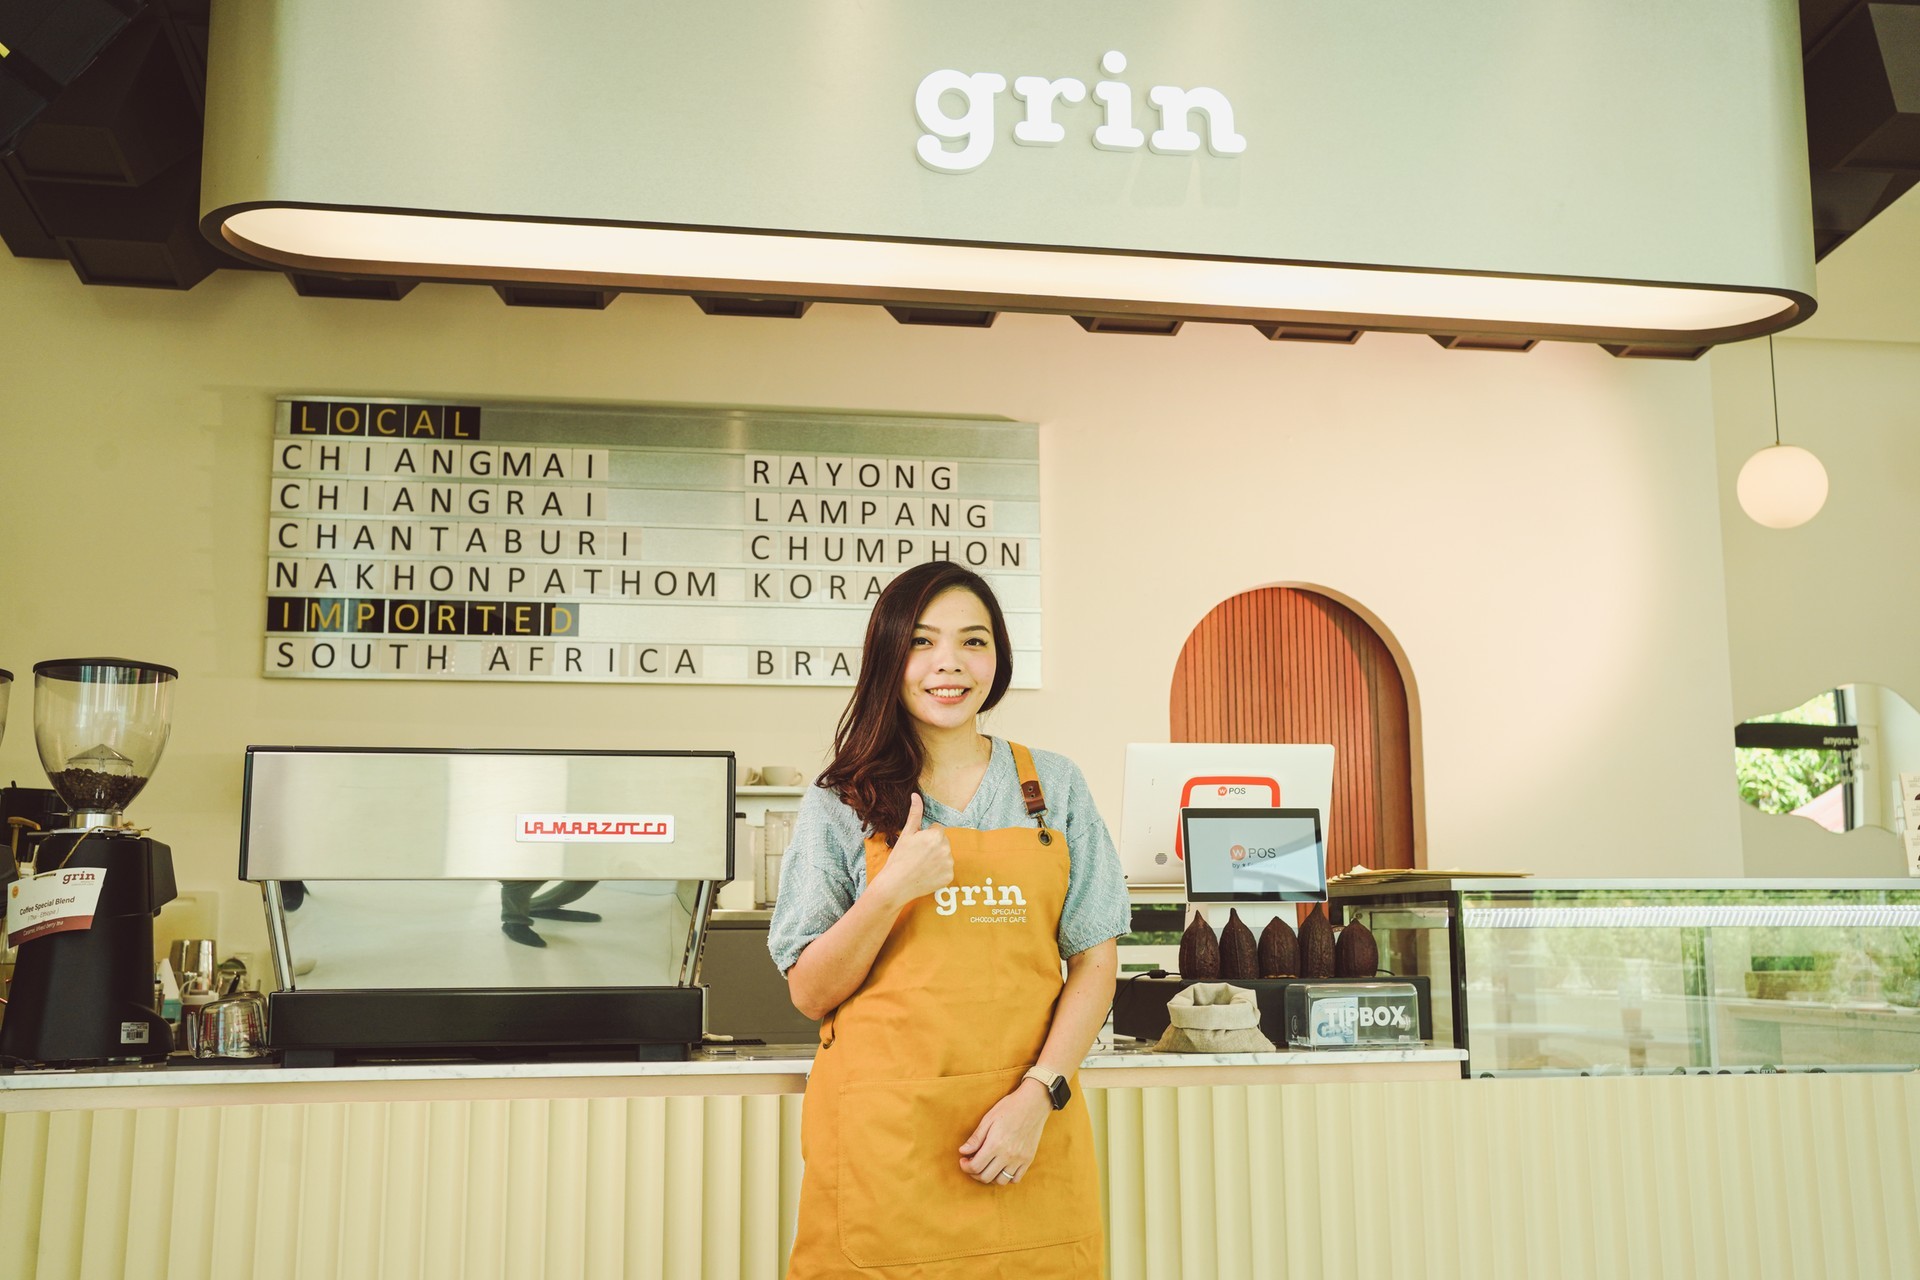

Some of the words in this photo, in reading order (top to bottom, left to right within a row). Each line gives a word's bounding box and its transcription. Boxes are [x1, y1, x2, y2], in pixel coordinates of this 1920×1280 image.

[914, 50, 1247, 174] grin
[301, 406, 469, 437] LOCAL
[281, 444, 593, 479] CHIANGMAI
[753, 460, 951, 490] RAYONG
[279, 484, 592, 517] CHIANGRAI
[755, 498, 987, 528] LAMPANG
[278, 522, 628, 556] CHANTABURI
[751, 535, 1020, 566] CHUMPHON
[275, 562, 717, 597] NAKHONPATHOM
[282, 601, 573, 634] IMPORTED
[277, 642, 447, 670] SOUTH
[488, 645, 697, 674] AFRICA
[1823, 737, 1851, 747] anyone
[1229, 787, 1246, 795] POS
[1248, 847, 1276, 858] POS
[63, 870, 95, 884] grin
[20, 906, 34, 916] Coffee
[35, 899, 54, 911] Special
[55, 896, 75, 905] Blend
[934, 877, 1027, 916] grin
[1324, 1006, 1406, 1028] TIPBOX
